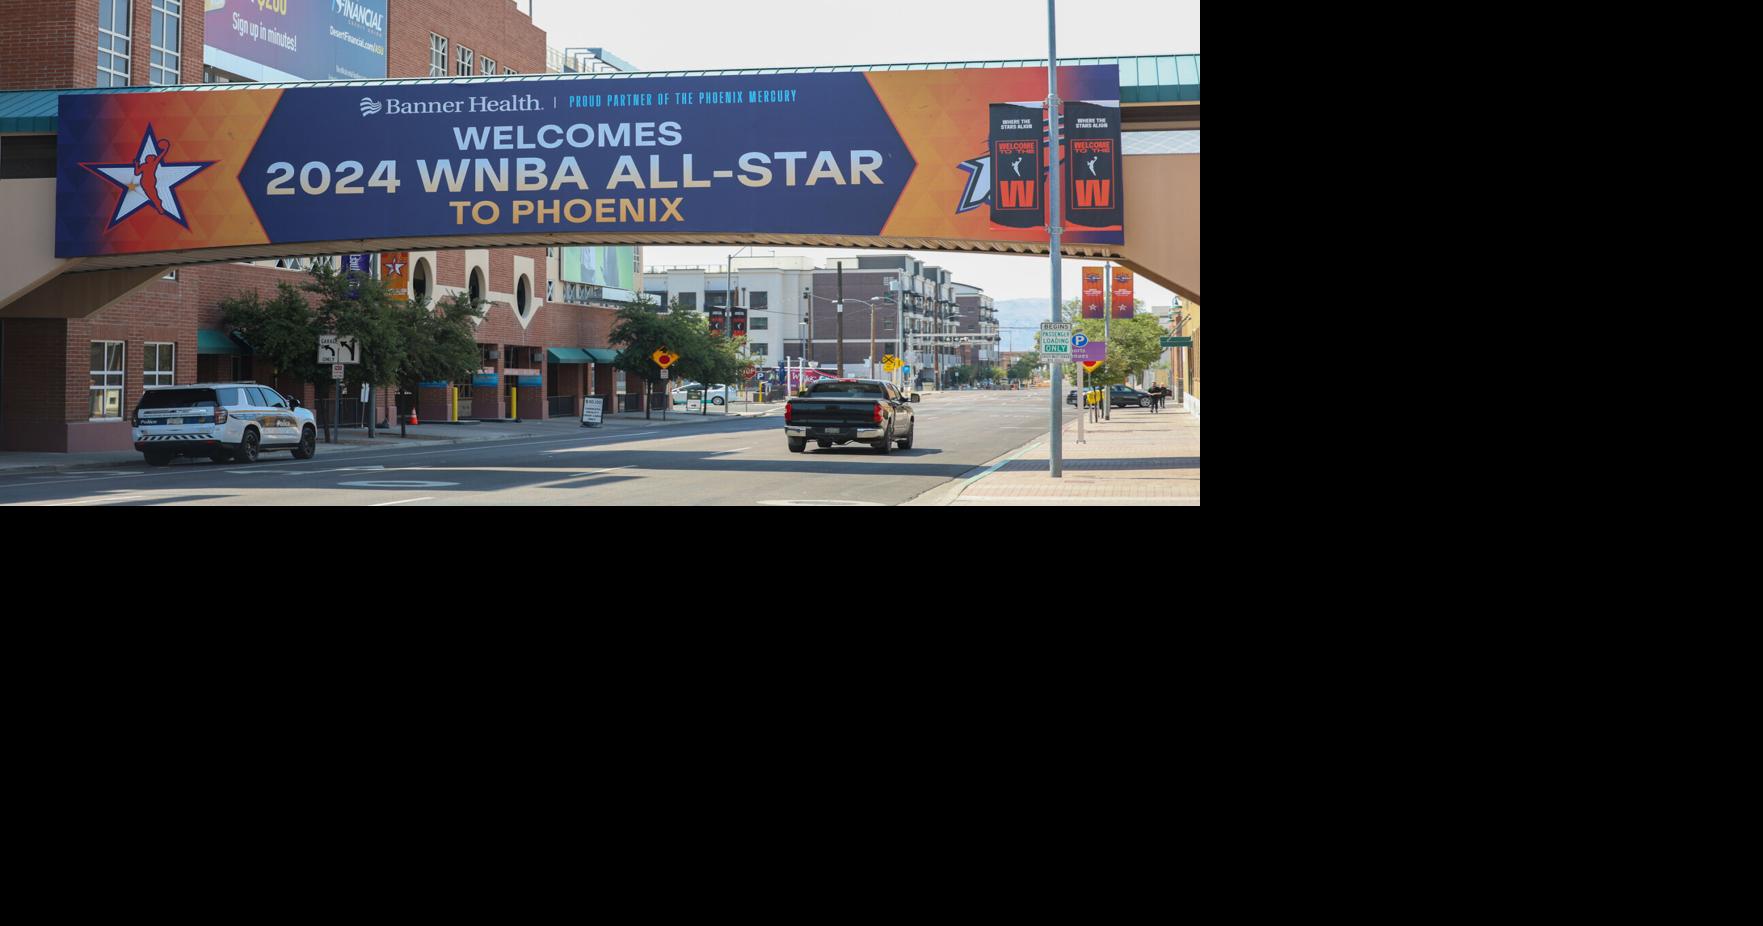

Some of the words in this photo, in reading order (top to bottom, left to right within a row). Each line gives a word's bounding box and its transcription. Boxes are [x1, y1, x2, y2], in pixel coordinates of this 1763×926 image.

[232, 11, 249, 37] Sign
[250, 22, 259, 42] up
[259, 21, 267, 41] in
[267, 26, 297, 52] minutes!
[385, 98, 464, 115] Banner
[569, 94, 601, 108] PROUD
[607, 93, 652, 107] PARTNER
[657, 92, 670, 106] OF
[675, 92, 693, 105] THE
[699, 90, 743, 104] PHOENIX
[748, 89, 797, 103] MERCURY
[453, 121, 682, 150] WELCOMES
[999, 142, 1035, 150] WELCOME
[1073, 141, 1110, 150] WELCOME
[266, 159, 400, 196] 2024
[416, 156, 589, 193] WNBA
[606, 149, 884, 190] ALL-STAR
[1000, 180, 1035, 208] W
[1075, 179, 1110, 207] W
[449, 200, 500, 225] TO
[512, 197, 684, 224] PHOENIX
[1075, 335, 1085, 345] P
